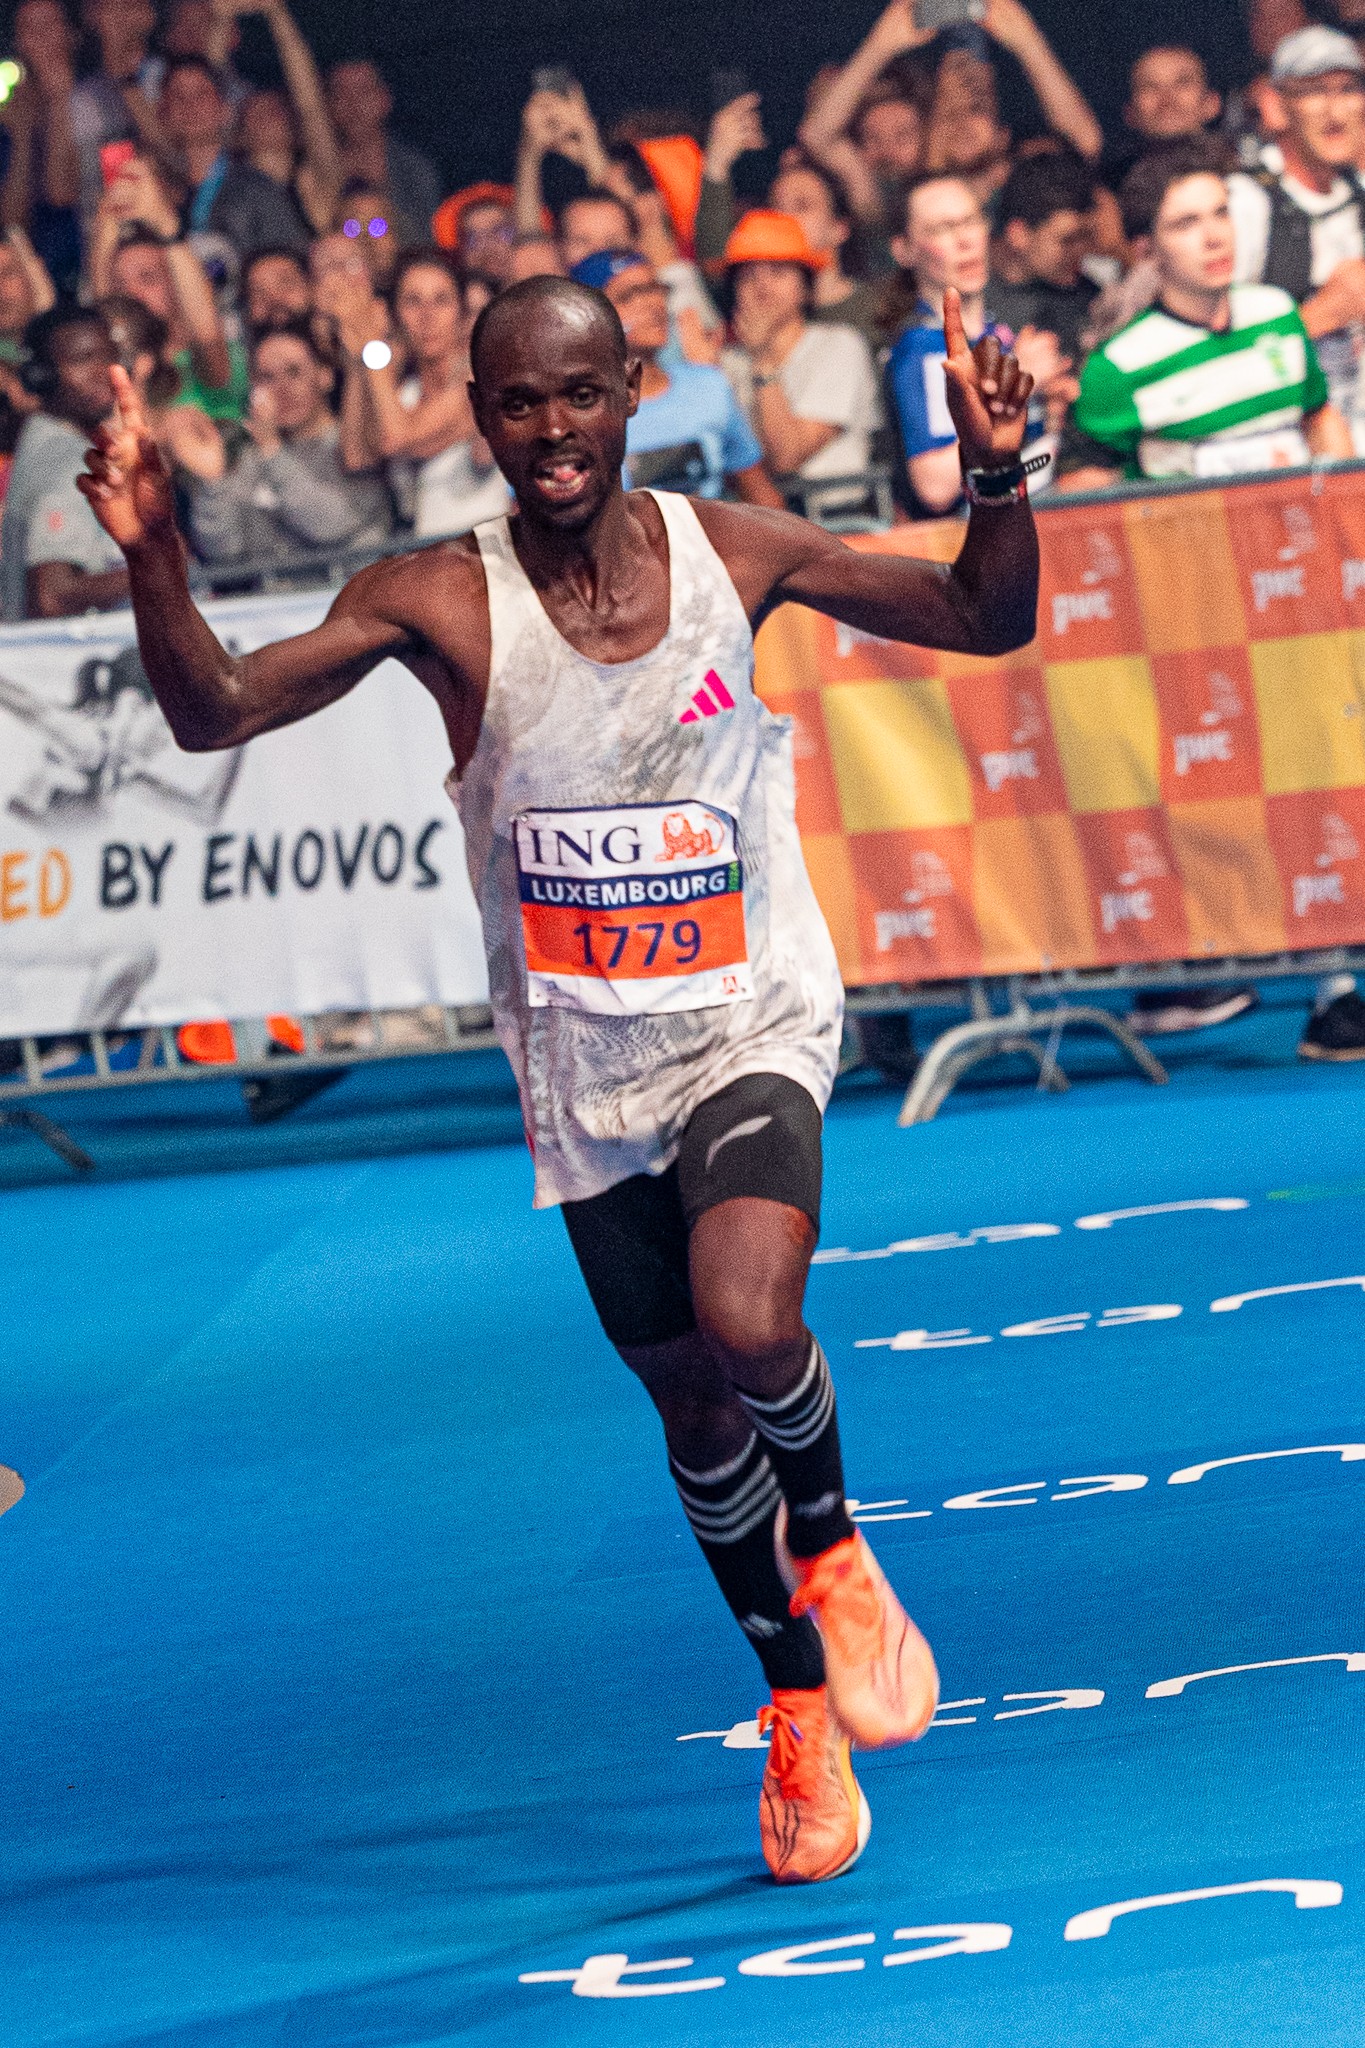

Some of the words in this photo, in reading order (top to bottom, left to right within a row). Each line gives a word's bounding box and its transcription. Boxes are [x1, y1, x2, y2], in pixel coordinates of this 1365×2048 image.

[101, 841, 175, 911] BY
[203, 819, 443, 906] ENOVOS
[529, 825, 644, 867] ING
[531, 870, 727, 906] LUXEMBOURG
[573, 919, 702, 969] 1779
